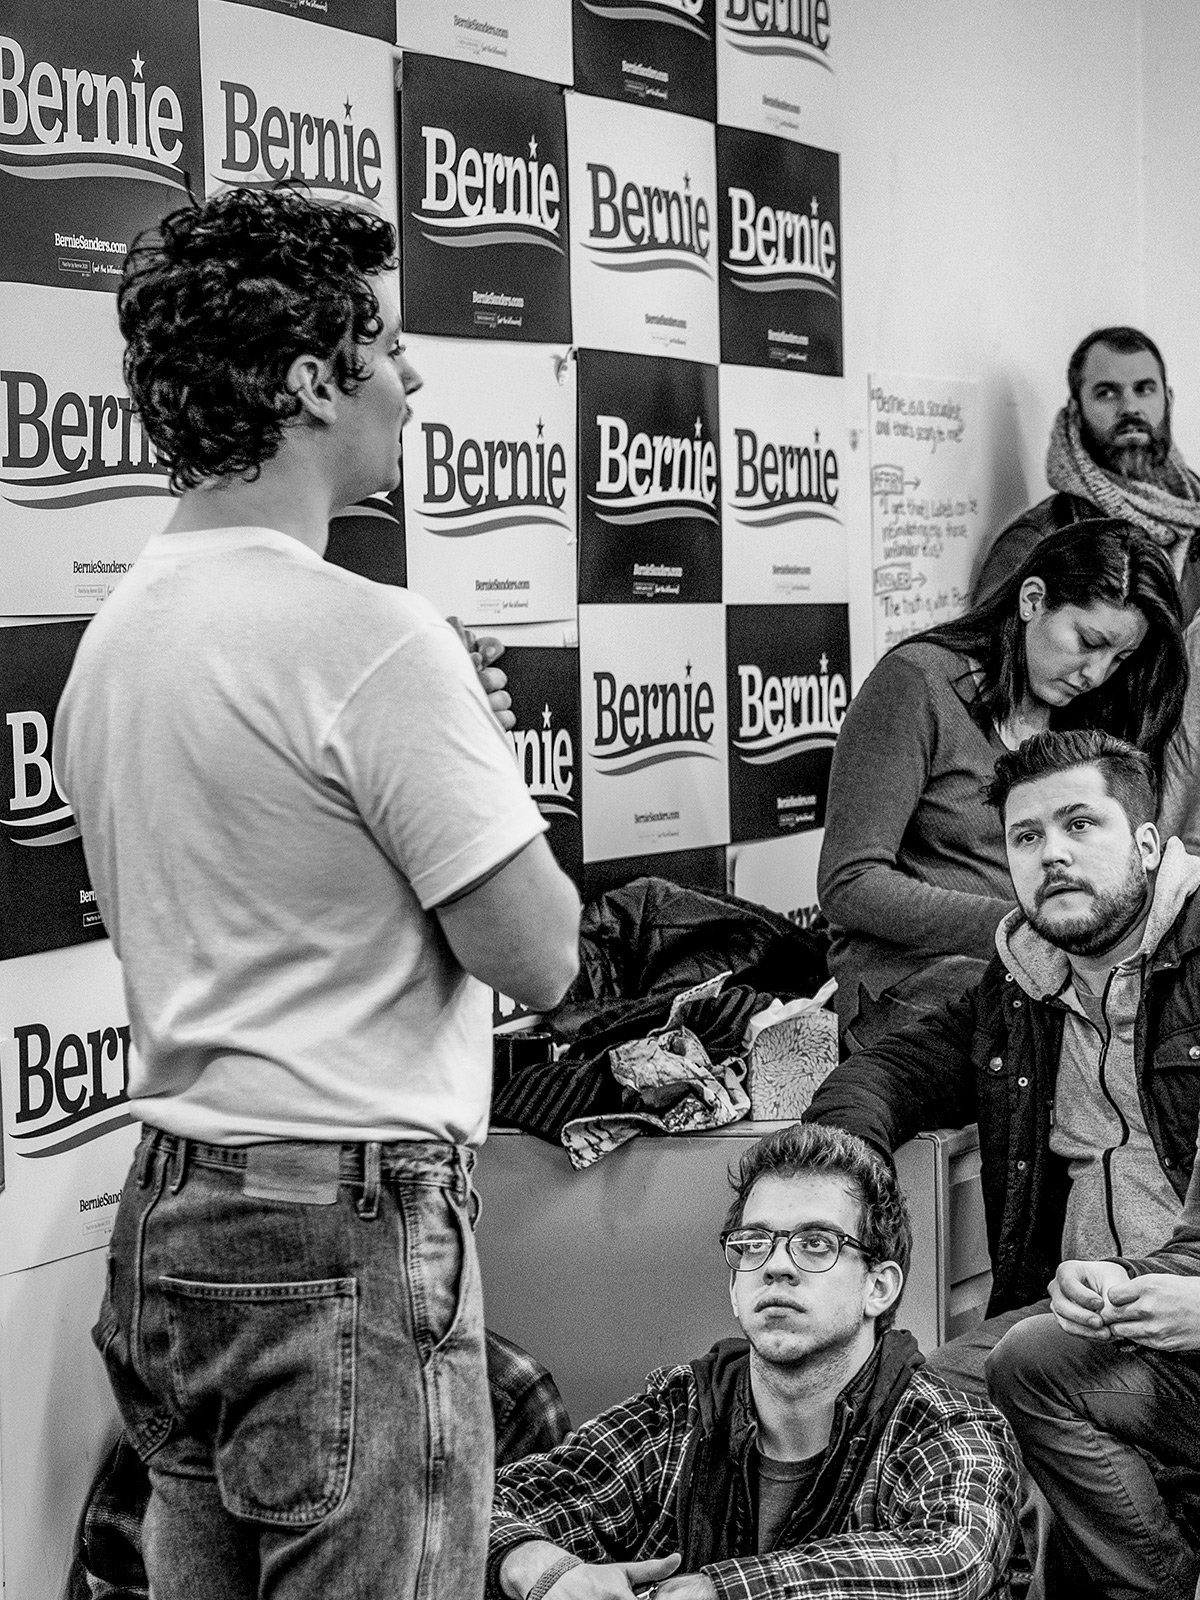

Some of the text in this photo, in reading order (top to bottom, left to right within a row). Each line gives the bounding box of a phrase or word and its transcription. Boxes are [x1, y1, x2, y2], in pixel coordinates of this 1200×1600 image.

[0, 35, 184, 164] Bernie
[219, 80, 383, 200] Bernie
[421, 126, 560, 232] Bernie
[586, 162, 711, 258] Bernie
[54, 232, 128, 254] BernieSanders.com
[728, 186, 837, 280] Bernie
[1, 370, 160, 473] Bern
[421, 417, 567, 508] Bernie
[597, 415, 719, 505] Bernie
[734, 428, 840, 507] Bernie
[593, 659, 715, 747] Bernie
[737, 652, 849, 738] Bernie
[505, 703, 574, 796] nie
[13, 1023, 131, 1124] Ber
[79, 1189, 123, 1212] BernieSand
